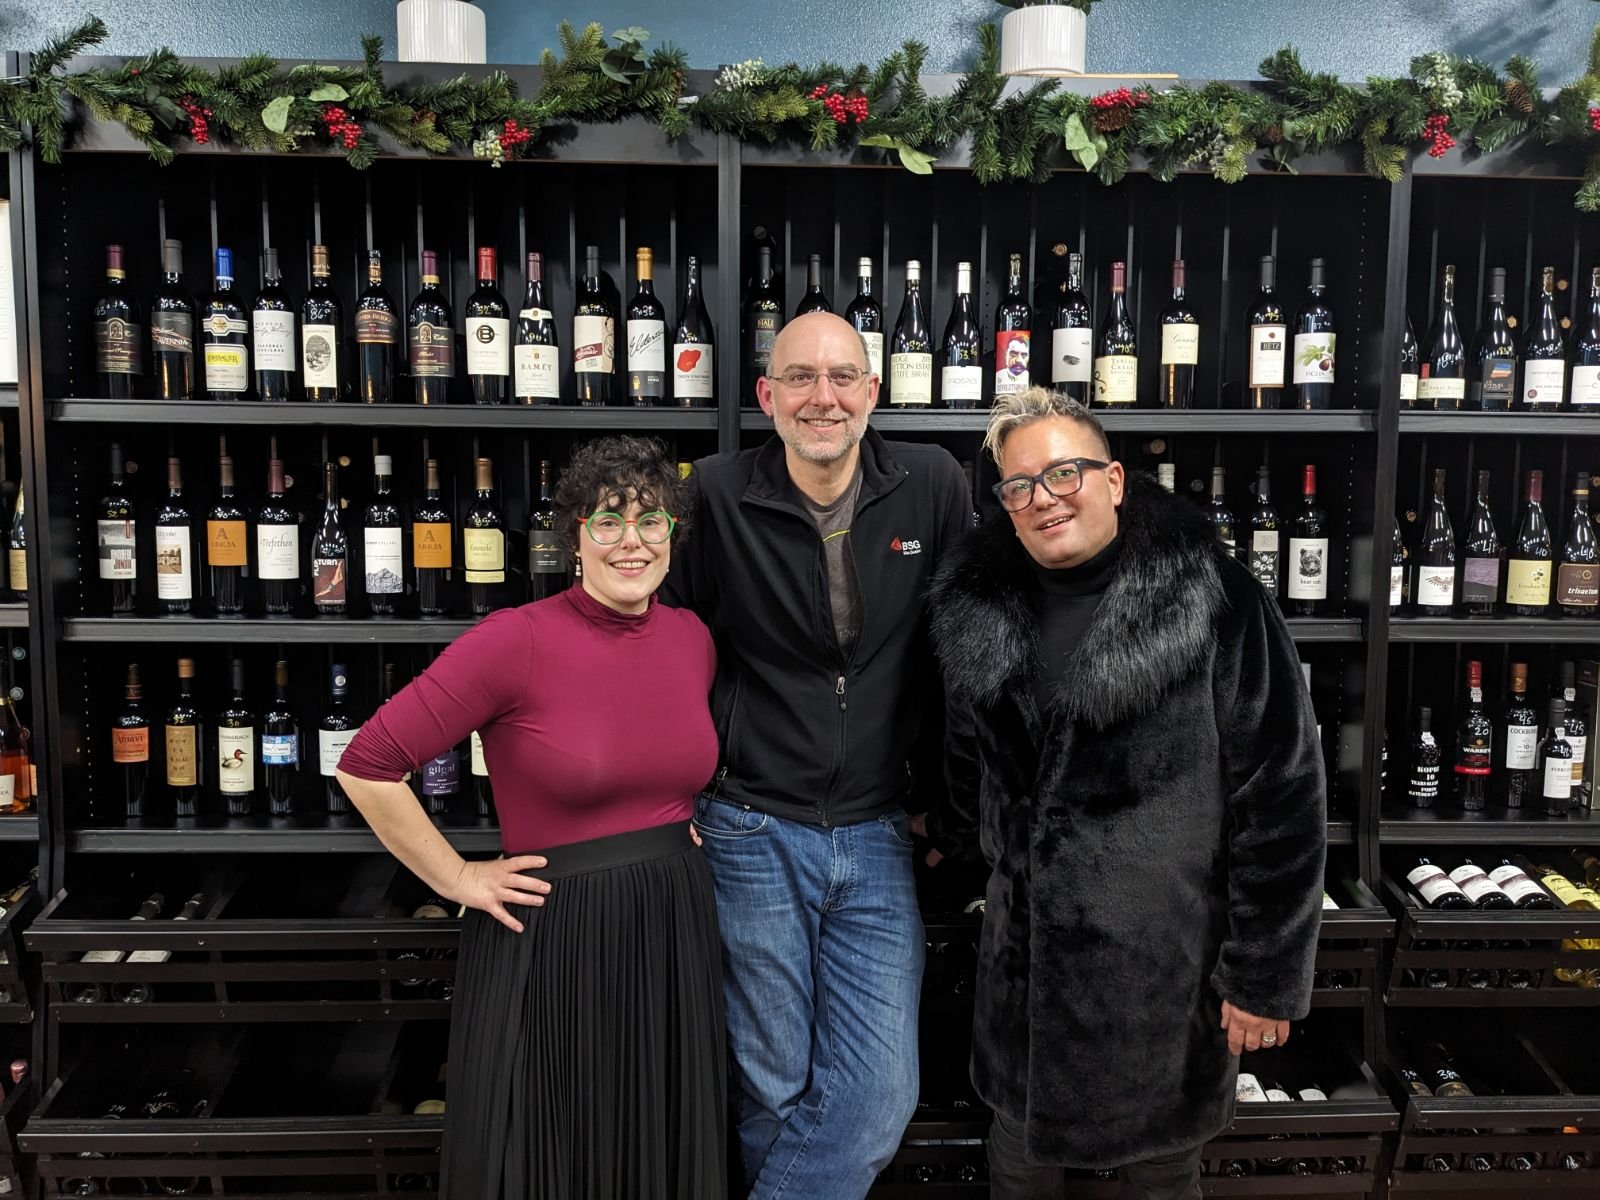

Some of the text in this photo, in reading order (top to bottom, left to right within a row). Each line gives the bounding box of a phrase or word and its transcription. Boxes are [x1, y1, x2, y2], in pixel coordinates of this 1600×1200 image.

[157, 337, 189, 346] AVENNIA
[1262, 342, 1281, 350] BETZ
[521, 363, 552, 371] RAMEY
[215, 527, 229, 540] A
[423, 529, 436, 542] A
[260, 532, 293, 552] Trefethen
[901, 539, 921, 551] BSG
[1474, 726, 1489, 736] 20
[428, 764, 455, 777] gilgal
[1426, 773, 1435, 781] 10
